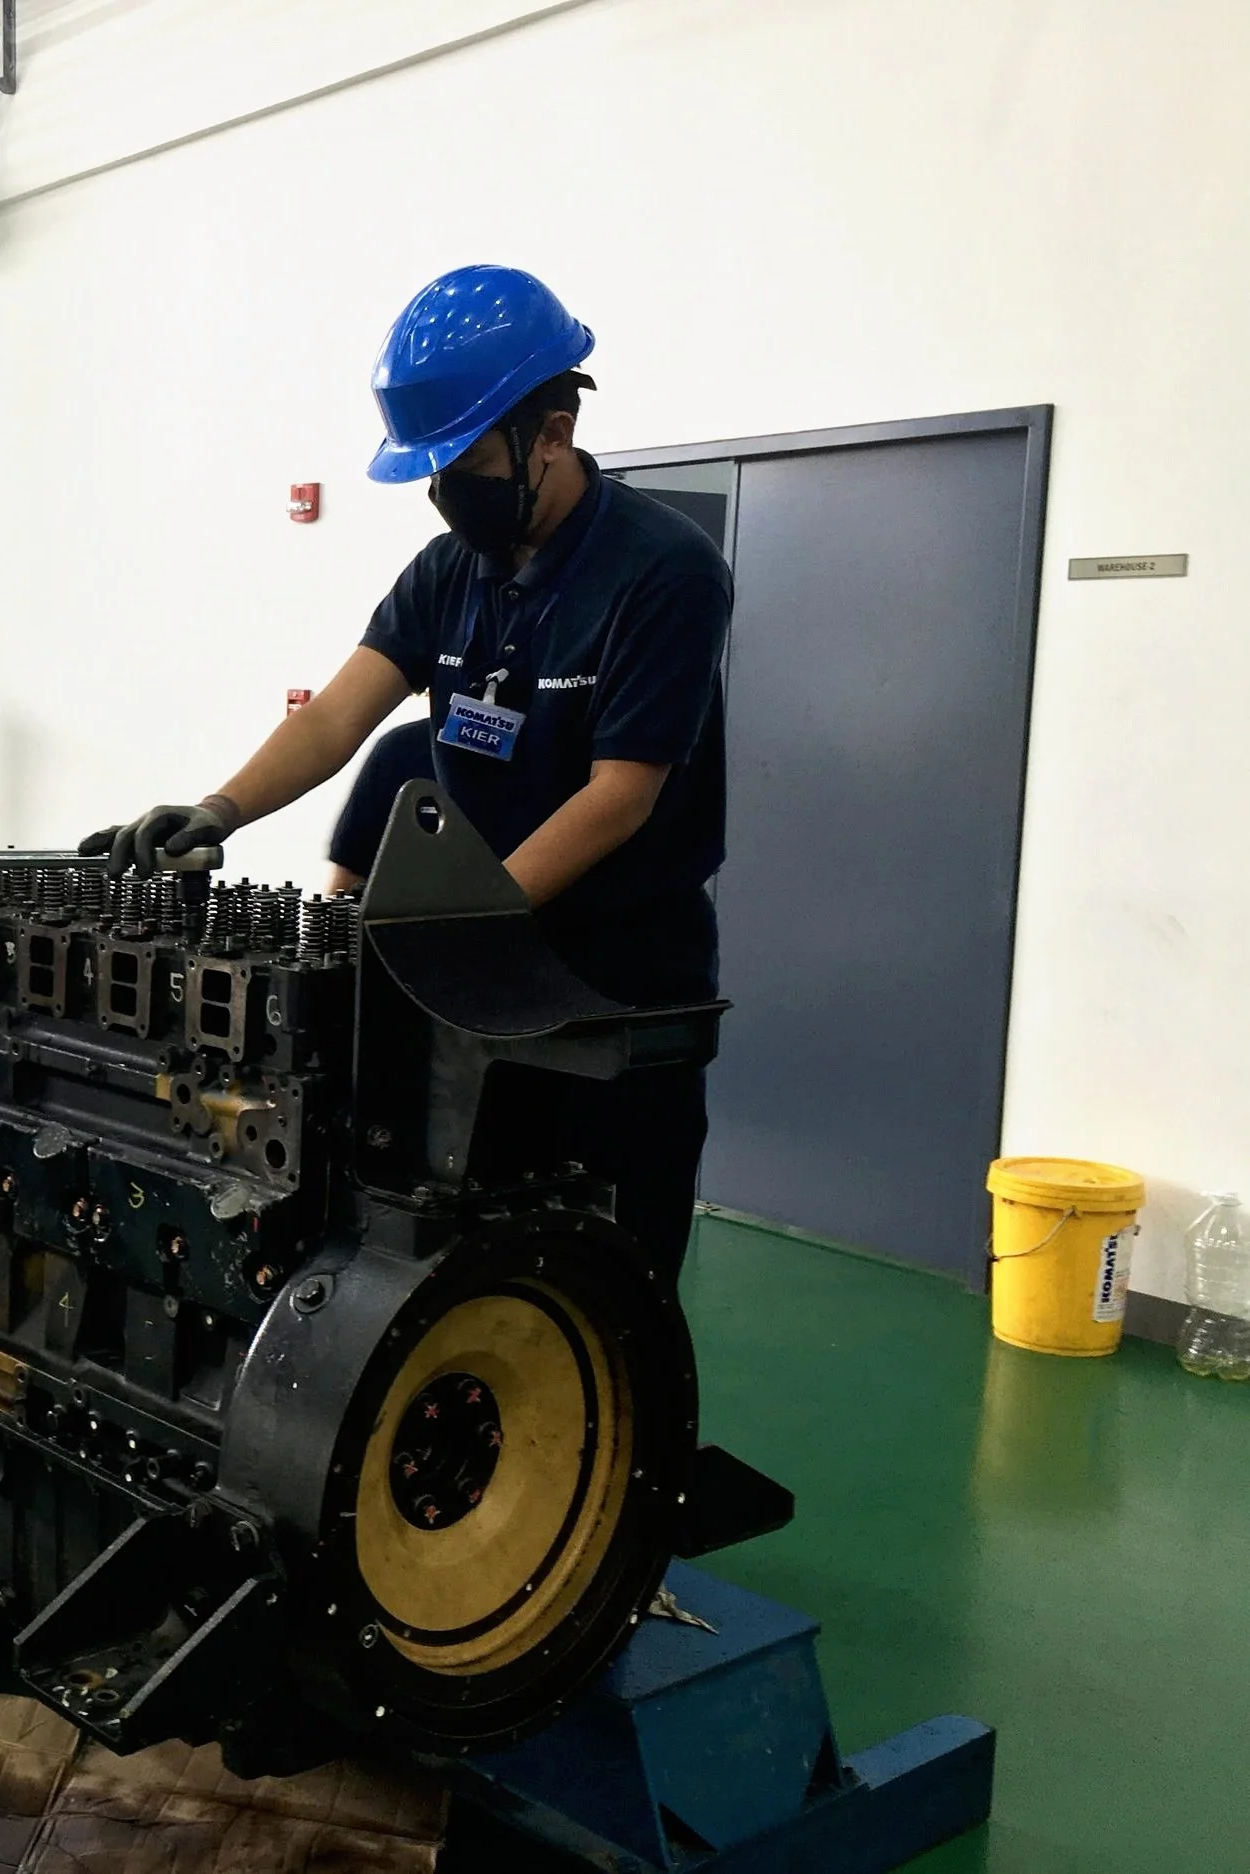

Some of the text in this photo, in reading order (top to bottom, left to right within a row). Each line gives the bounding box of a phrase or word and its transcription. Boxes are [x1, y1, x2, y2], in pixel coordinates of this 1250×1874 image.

[538, 675, 597, 690] KOMATSU
[456, 706, 515, 731] KOMATSU
[460, 726, 501, 746] KIER
[82, 957, 95, 986] 4
[169, 972, 185, 1003] 5
[265, 994, 282, 1027] 6
[128, 1181, 146, 1210] 3
[58, 1291, 76, 1329] 4
